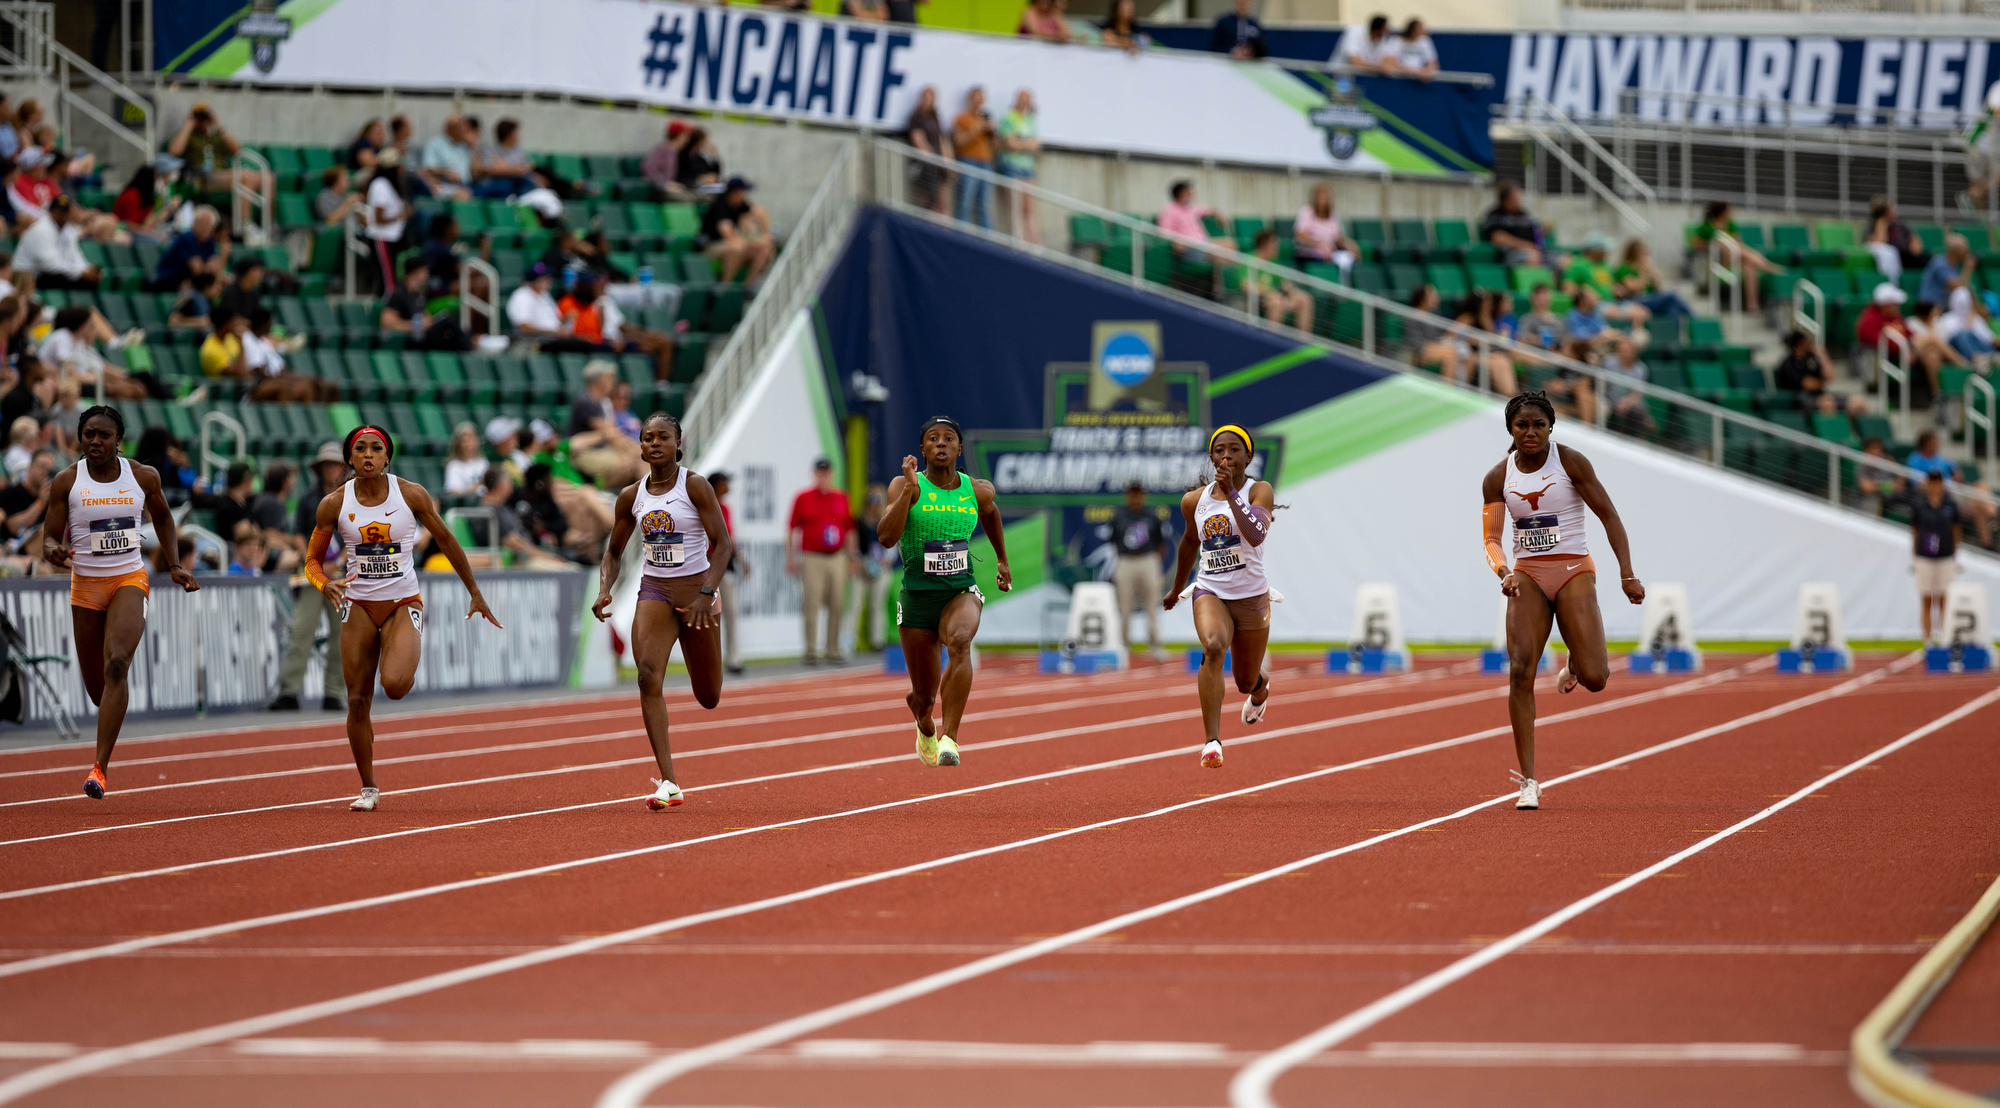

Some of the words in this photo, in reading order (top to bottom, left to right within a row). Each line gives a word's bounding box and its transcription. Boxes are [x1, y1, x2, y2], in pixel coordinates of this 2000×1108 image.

[643, 10, 913, 120] #NCAATF
[1504, 34, 1843, 128] HAYWARD
[81, 497, 134, 507] TENNESSEE
[922, 504, 976, 515] DUCKS
[103, 530, 125, 539] JOELLA
[1524, 528, 1550, 537] KYNNEDY
[100, 537, 129, 550] LLOYD
[1520, 534, 1559, 547] FLANNEL
[652, 551, 673, 562] OFILI
[937, 552, 957, 560] KEMBA
[1210, 549, 1233, 558] SYMONE
[360, 561, 399, 573] BARNES
[928, 558, 964, 571] NELSON
[1207, 554, 1240, 569] MASON
